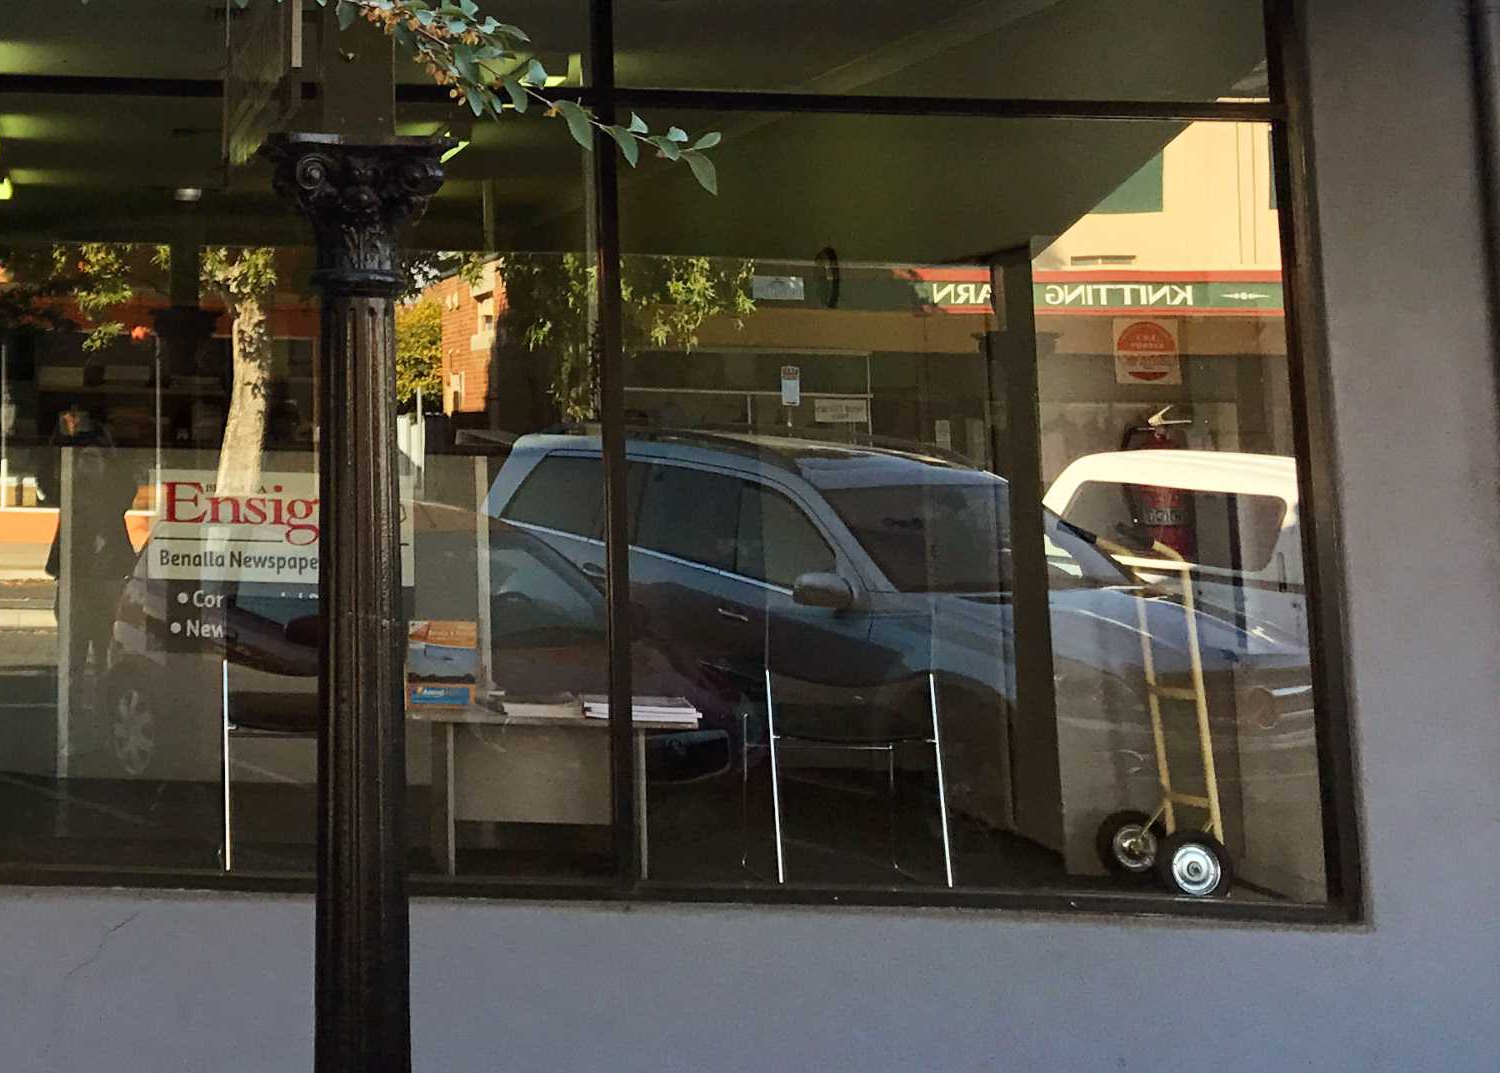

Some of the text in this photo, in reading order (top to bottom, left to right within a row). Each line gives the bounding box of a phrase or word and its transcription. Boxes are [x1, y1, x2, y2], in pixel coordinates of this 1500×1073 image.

[161, 481, 320, 546] Ensig
[159, 550, 319, 576] Benalla Newspape
